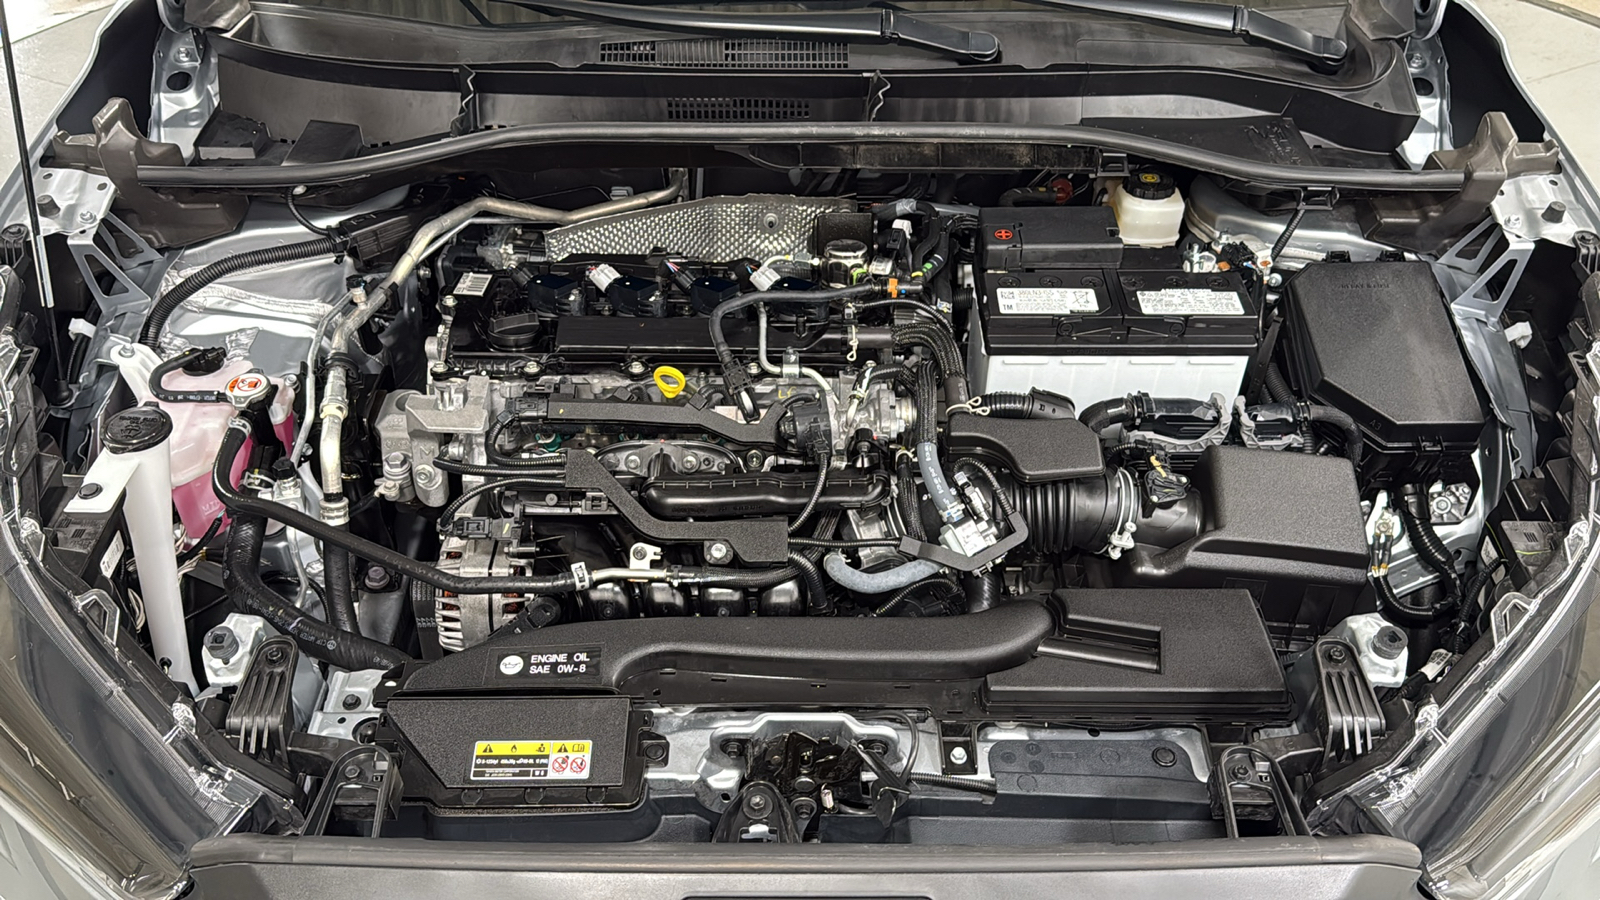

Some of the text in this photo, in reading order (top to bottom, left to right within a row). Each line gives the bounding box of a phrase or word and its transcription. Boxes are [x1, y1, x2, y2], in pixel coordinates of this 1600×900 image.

[530, 652, 590, 663] ENGINE OIL
[529, 664, 586, 674] SAE 0W-8
